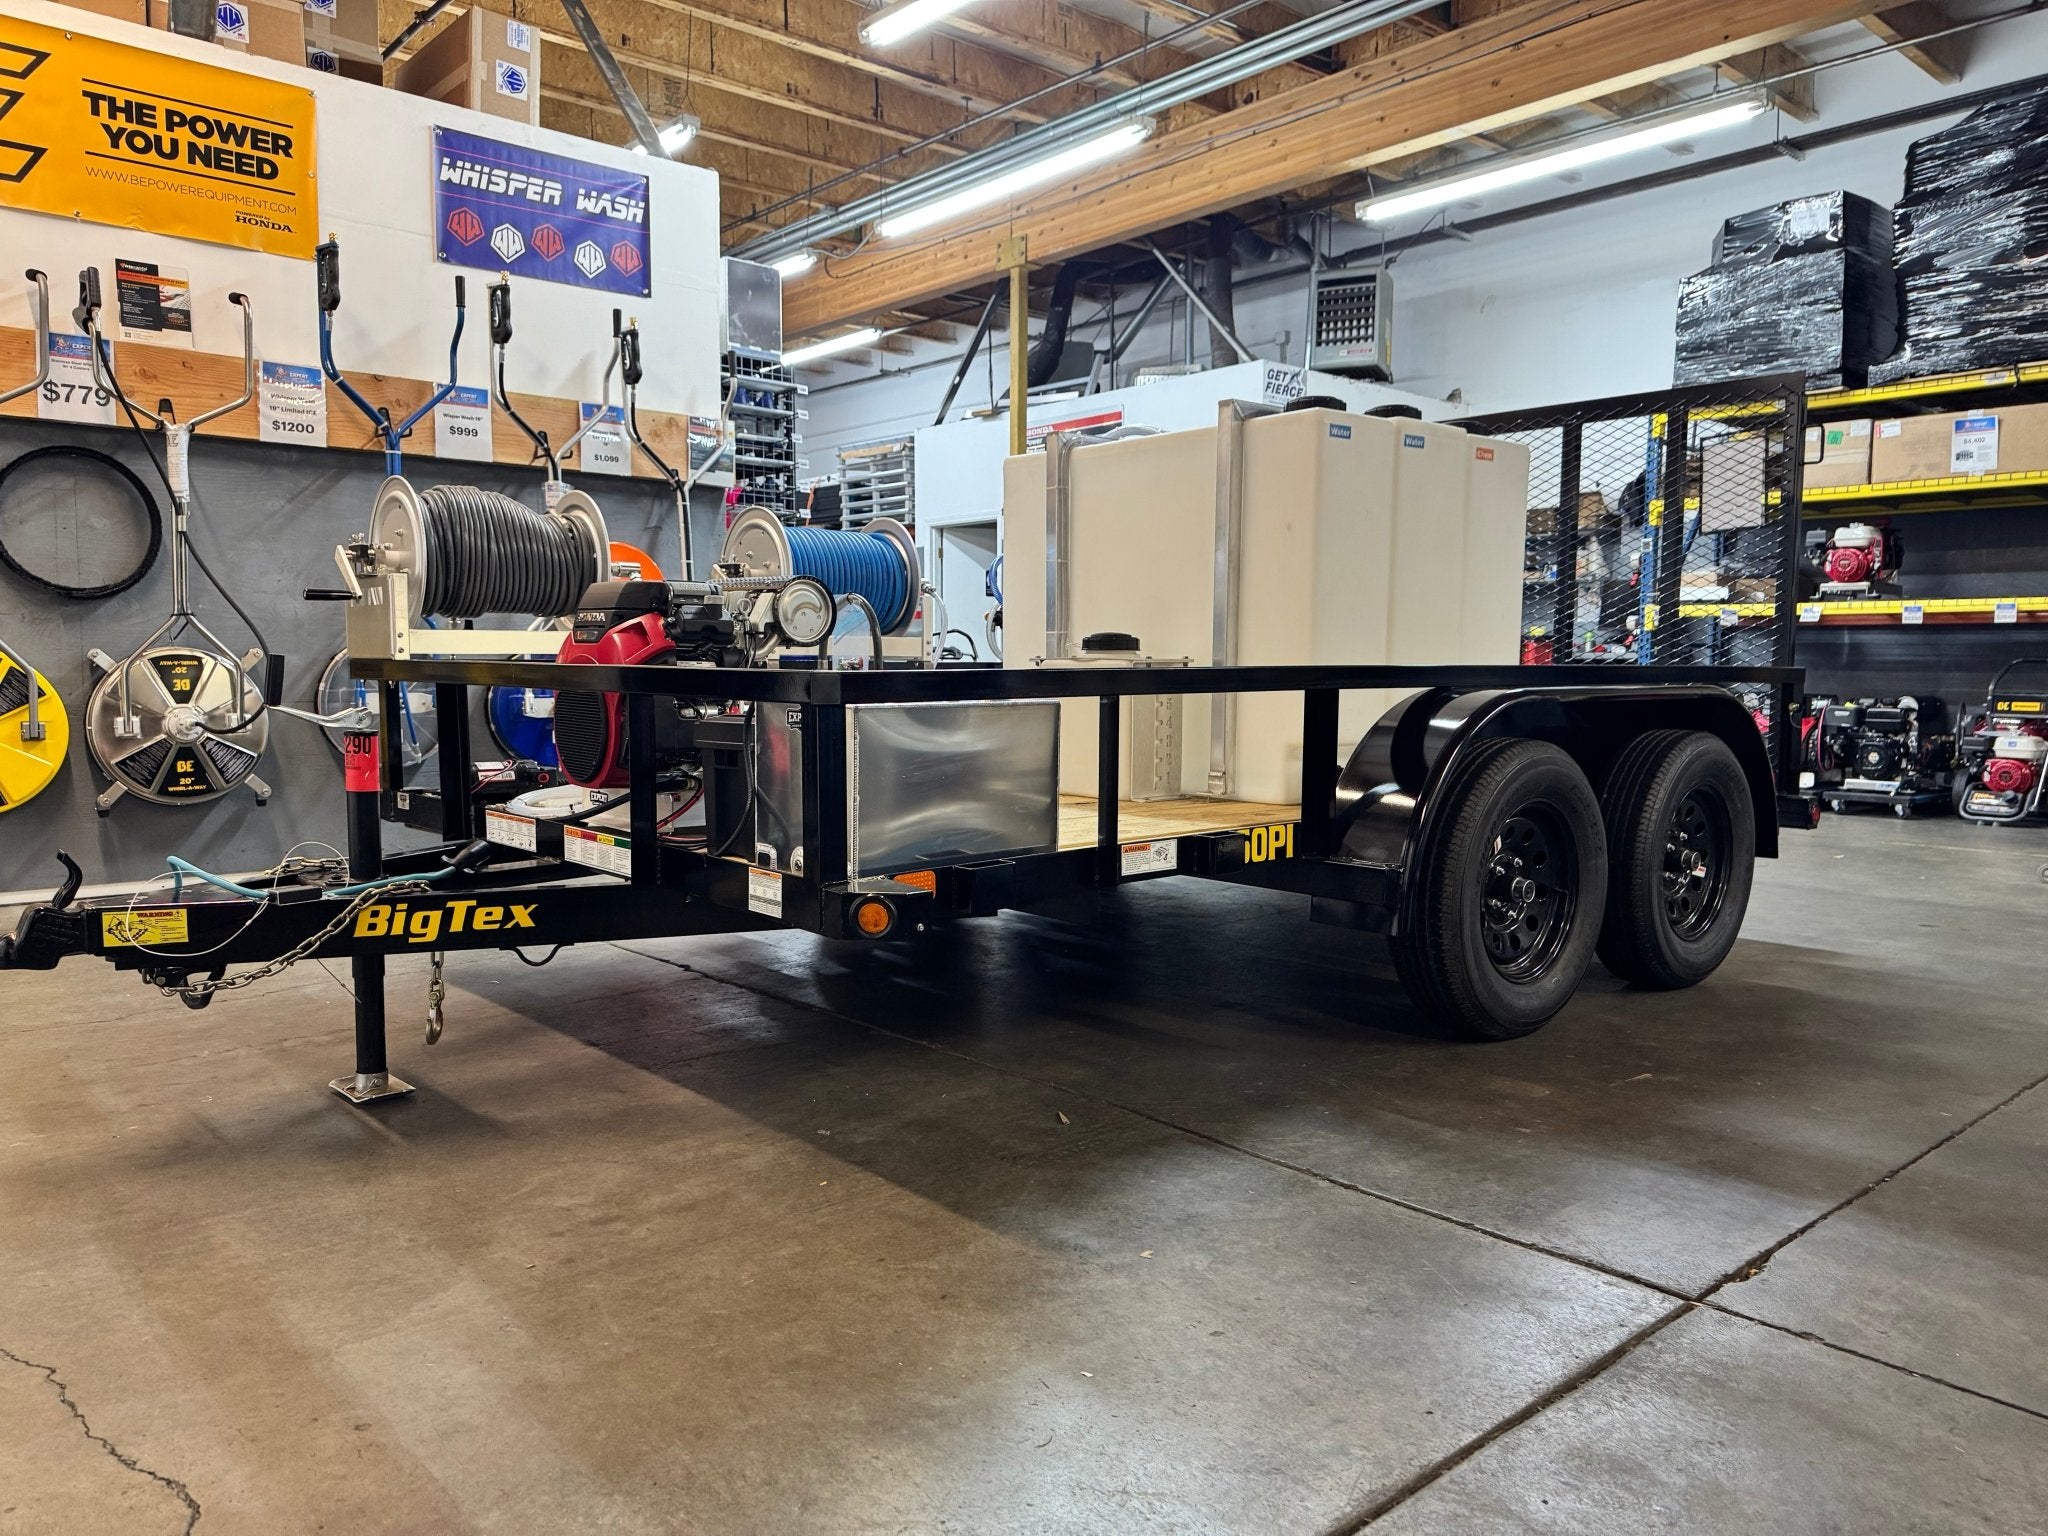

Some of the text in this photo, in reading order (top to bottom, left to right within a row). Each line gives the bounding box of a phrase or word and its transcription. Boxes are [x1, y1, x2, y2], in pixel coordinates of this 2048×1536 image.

[82, 90, 293, 158] THE POWER
[100, 122, 279, 180] YOU NEED
[85, 166, 297, 216] WWW.BEPOWEREQUIPMENT.COM
[440, 157, 645, 224] WHISPER WASH
[235, 210, 263, 219] POWERED
[235, 214, 294, 233] HONDA
[1267, 369, 1288, 382] GET
[42, 379, 111, 407] $779
[1265, 382, 1304, 397] FIERCE
[272, 419, 315, 434] $1200
[449, 425, 478, 437] $999
[1331, 426, 1350, 437] Water
[1405, 437, 1424, 447] Water
[594, 454, 619, 463] $1,099
[1476, 449, 1493, 459] Chem
[173, 679, 190, 691] BE
[345, 735, 372, 755] 290
[177, 760, 194, 772] BE
[353, 900, 539, 943] BigTex
